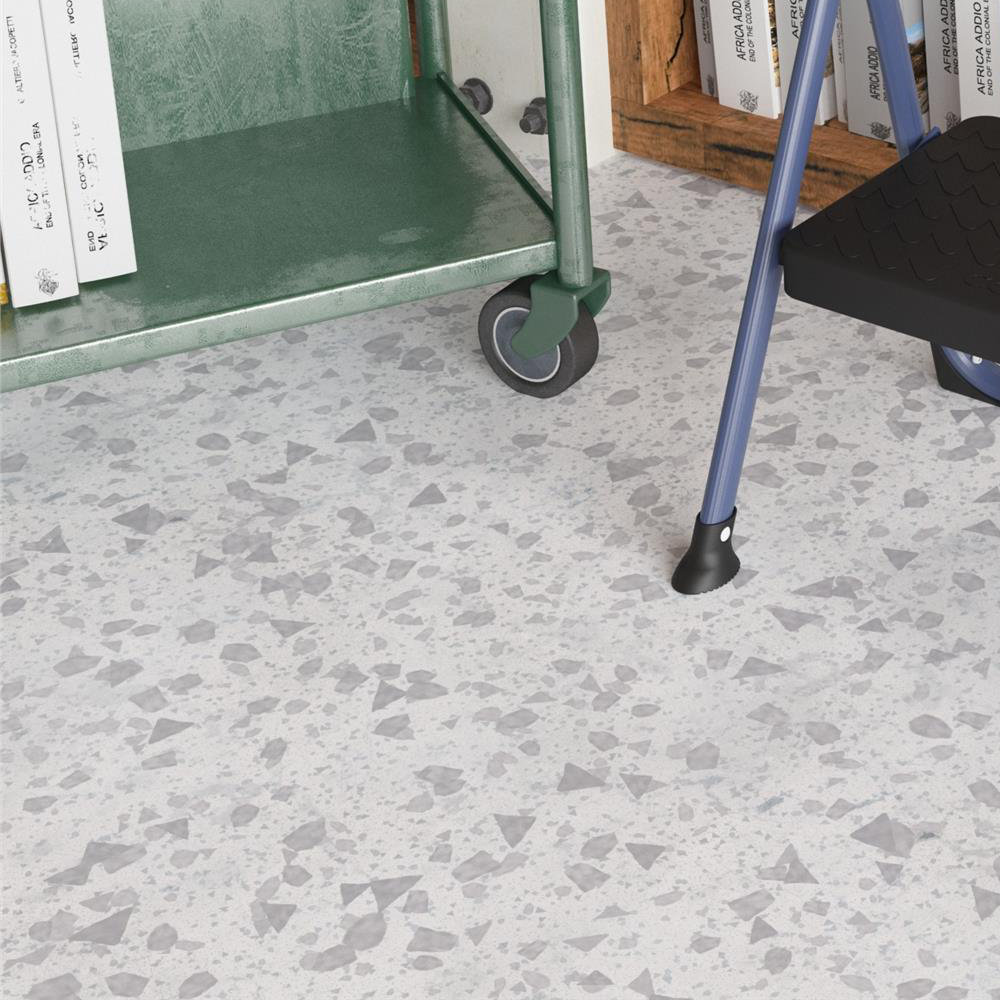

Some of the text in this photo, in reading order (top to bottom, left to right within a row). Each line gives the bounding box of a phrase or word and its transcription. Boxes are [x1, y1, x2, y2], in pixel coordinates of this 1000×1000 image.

[734, 24, 746, 60] AFRICA
[983, 5, 991, 45] COLONIAL
[941, 27, 953, 73] AFRICA
[973, 1, 985, 94] AFRICA ADDIO
[986, 65, 992, 77] OF
